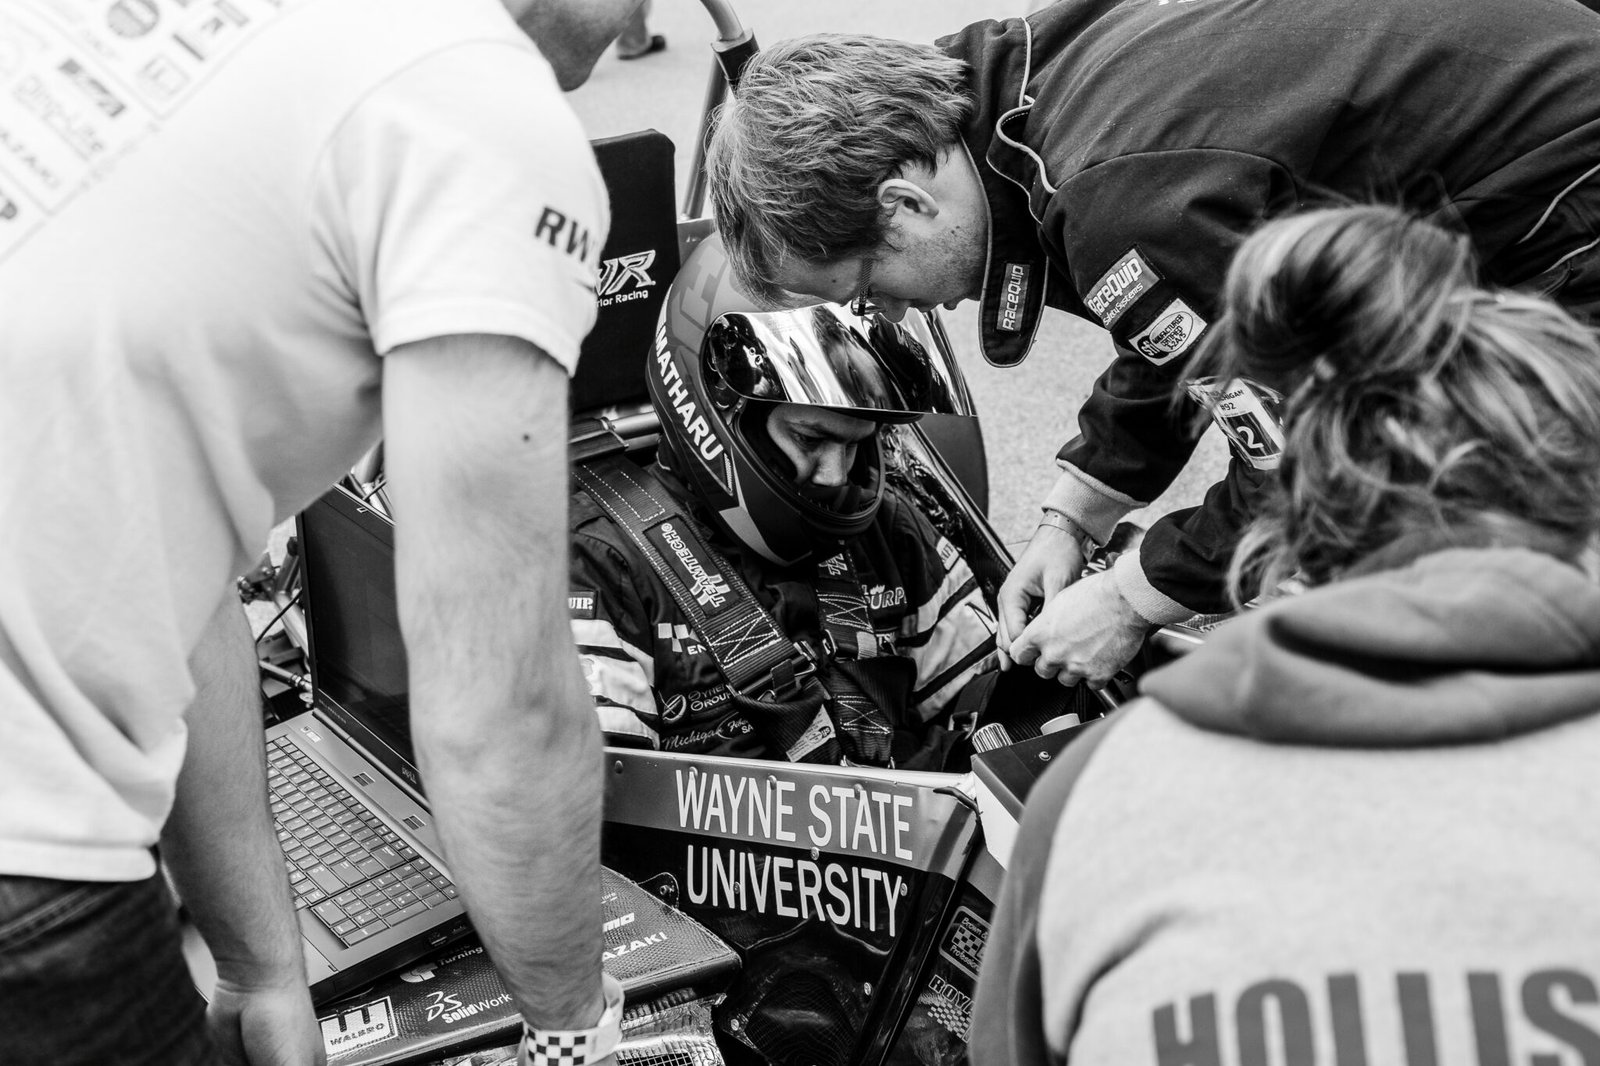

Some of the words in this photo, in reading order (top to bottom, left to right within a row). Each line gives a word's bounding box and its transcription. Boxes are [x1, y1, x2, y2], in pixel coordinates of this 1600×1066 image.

[615, 289, 649, 304] Racing
[655, 324, 724, 461] MATHARU
[1220, 402, 1236, 411] #92
[1236, 425, 1264, 449] 2
[675, 769, 797, 842] WAYNE
[807, 784, 913, 862] STATE
[687, 844, 903, 938] UNIVERSITY
[961, 916, 982, 937] Brown
[438, 946, 484, 966] Turning
[329, 1022, 385, 1046] WALBRO
